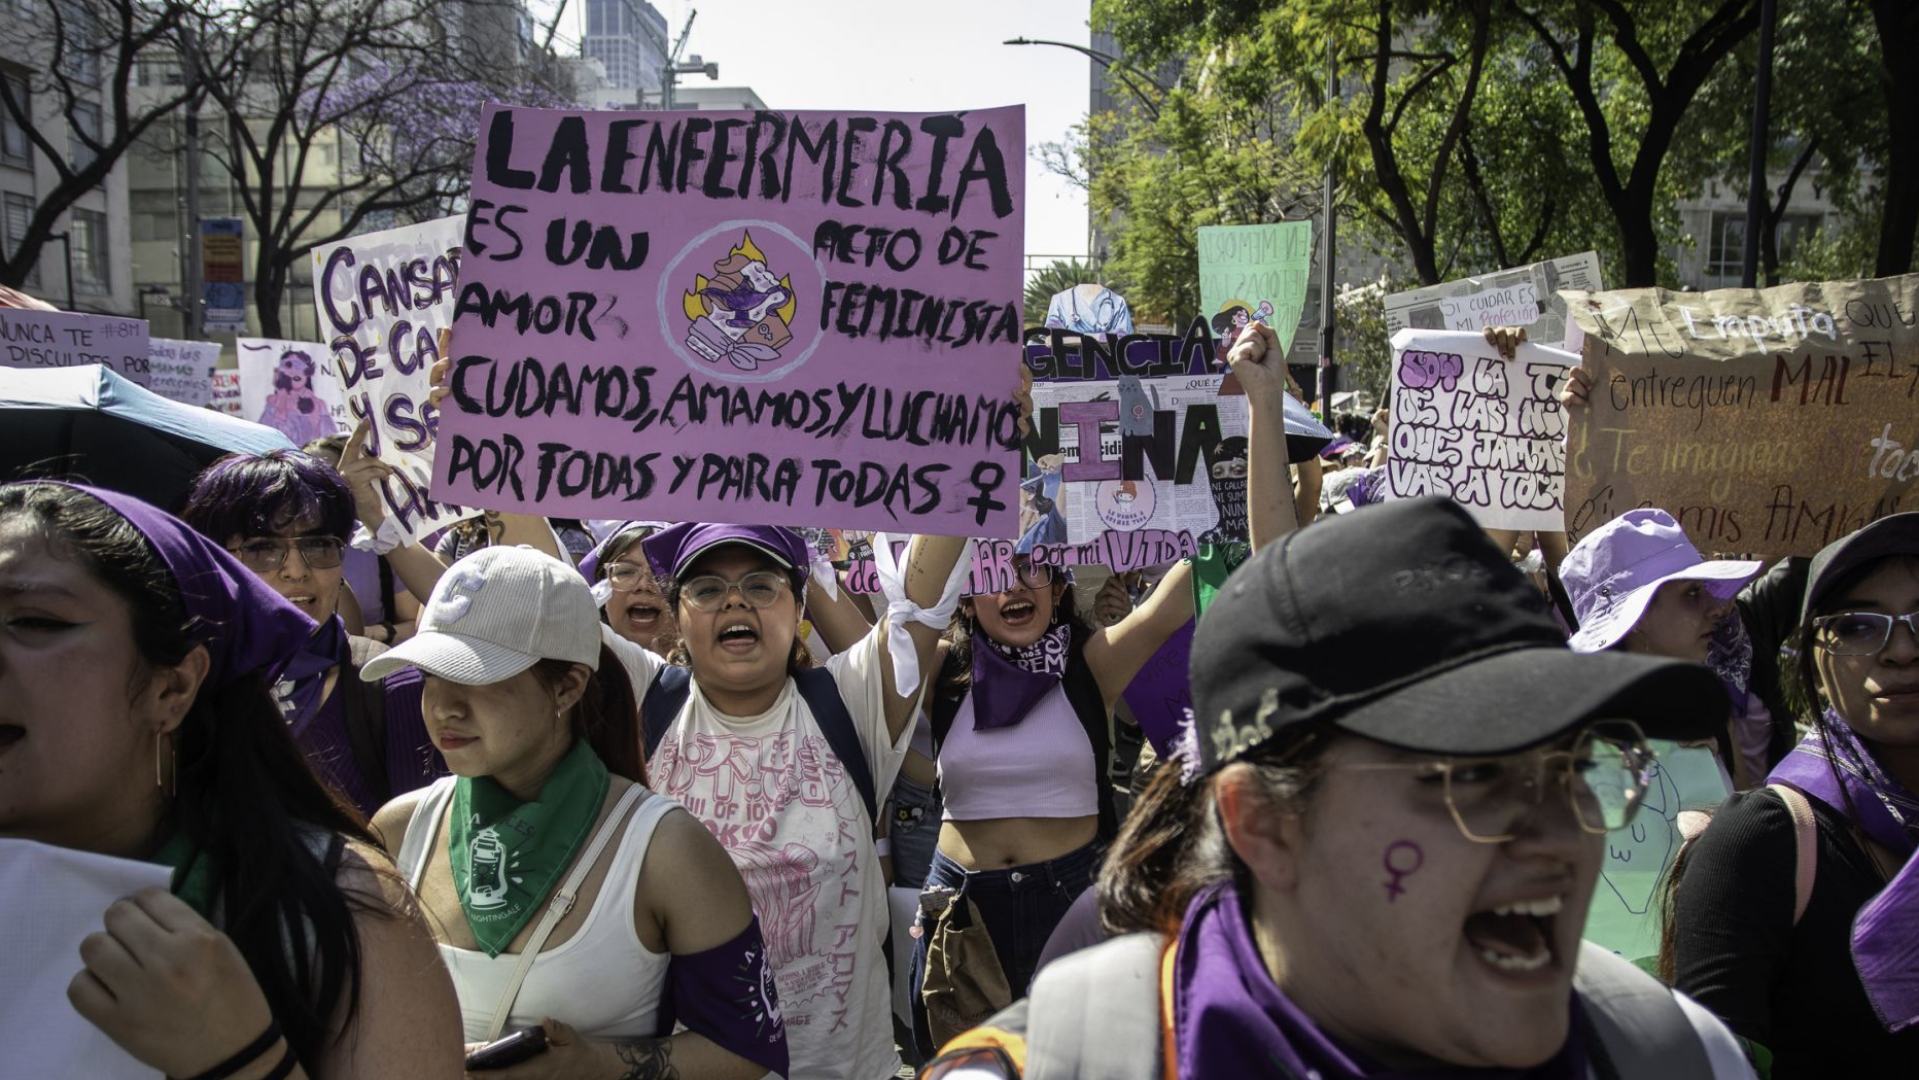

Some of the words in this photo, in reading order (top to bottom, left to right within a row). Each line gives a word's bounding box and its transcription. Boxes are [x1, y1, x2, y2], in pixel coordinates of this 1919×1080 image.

[485, 109, 593, 195] LA
[464, 199, 528, 262] ES
[545, 218, 649, 271] UN
[812, 219, 922, 272] ACTO
[937, 225, 1000, 270] DE
[453, 281, 599, 342] AMOR
[821, 281, 1021, 348] FEMINISTA
[1456, 316, 1473, 331] MI
[1469, 290, 1516, 312] CUIDAR
[1519, 286, 1536, 306] ES
[0, 314, 55, 344] NUNCA
[63, 328, 93, 347] TE
[100, 323, 140, 339] #8M
[330, 334, 384, 390] DE
[388, 319, 441, 377] CA
[124, 356, 150, 374] POR
[1397, 350, 1464, 393] SOY
[1472, 357, 1510, 399] LA
[1769, 354, 1851, 407] MAL
[862, 386, 1022, 452] LUCHAMO
[1397, 386, 1440, 428] DE
[1451, 389, 1509, 435] LAS
[1392, 423, 1463, 466] QUE
[448, 434, 525, 502] POR
[535, 442, 662, 502] TODAS
[668, 455, 697, 495] Y
[697, 452, 801, 506] PARA
[811, 458, 952, 522] TODAS
[1388, 457, 1454, 498] VAS
[702, 815, 778, 848] OKYO
[714, 802, 739, 820] OF
